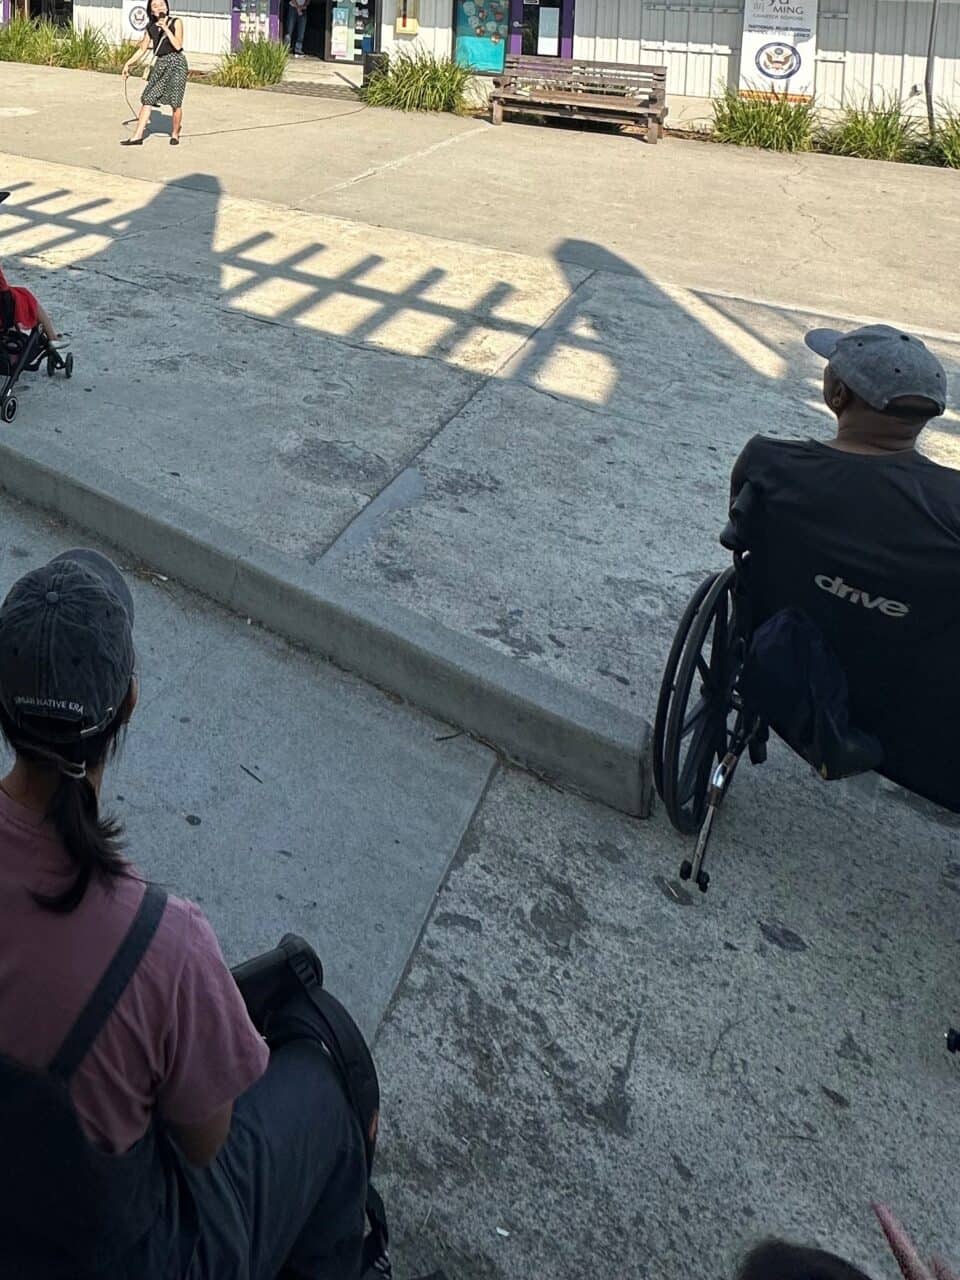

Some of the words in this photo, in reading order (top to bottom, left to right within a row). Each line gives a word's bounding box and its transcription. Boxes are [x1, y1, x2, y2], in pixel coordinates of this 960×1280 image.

[773, 5, 804, 15] MING
[814, 574, 909, 617] drive
[36, 697, 67, 709] NATIVE
[69, 701, 84, 715] ERA
